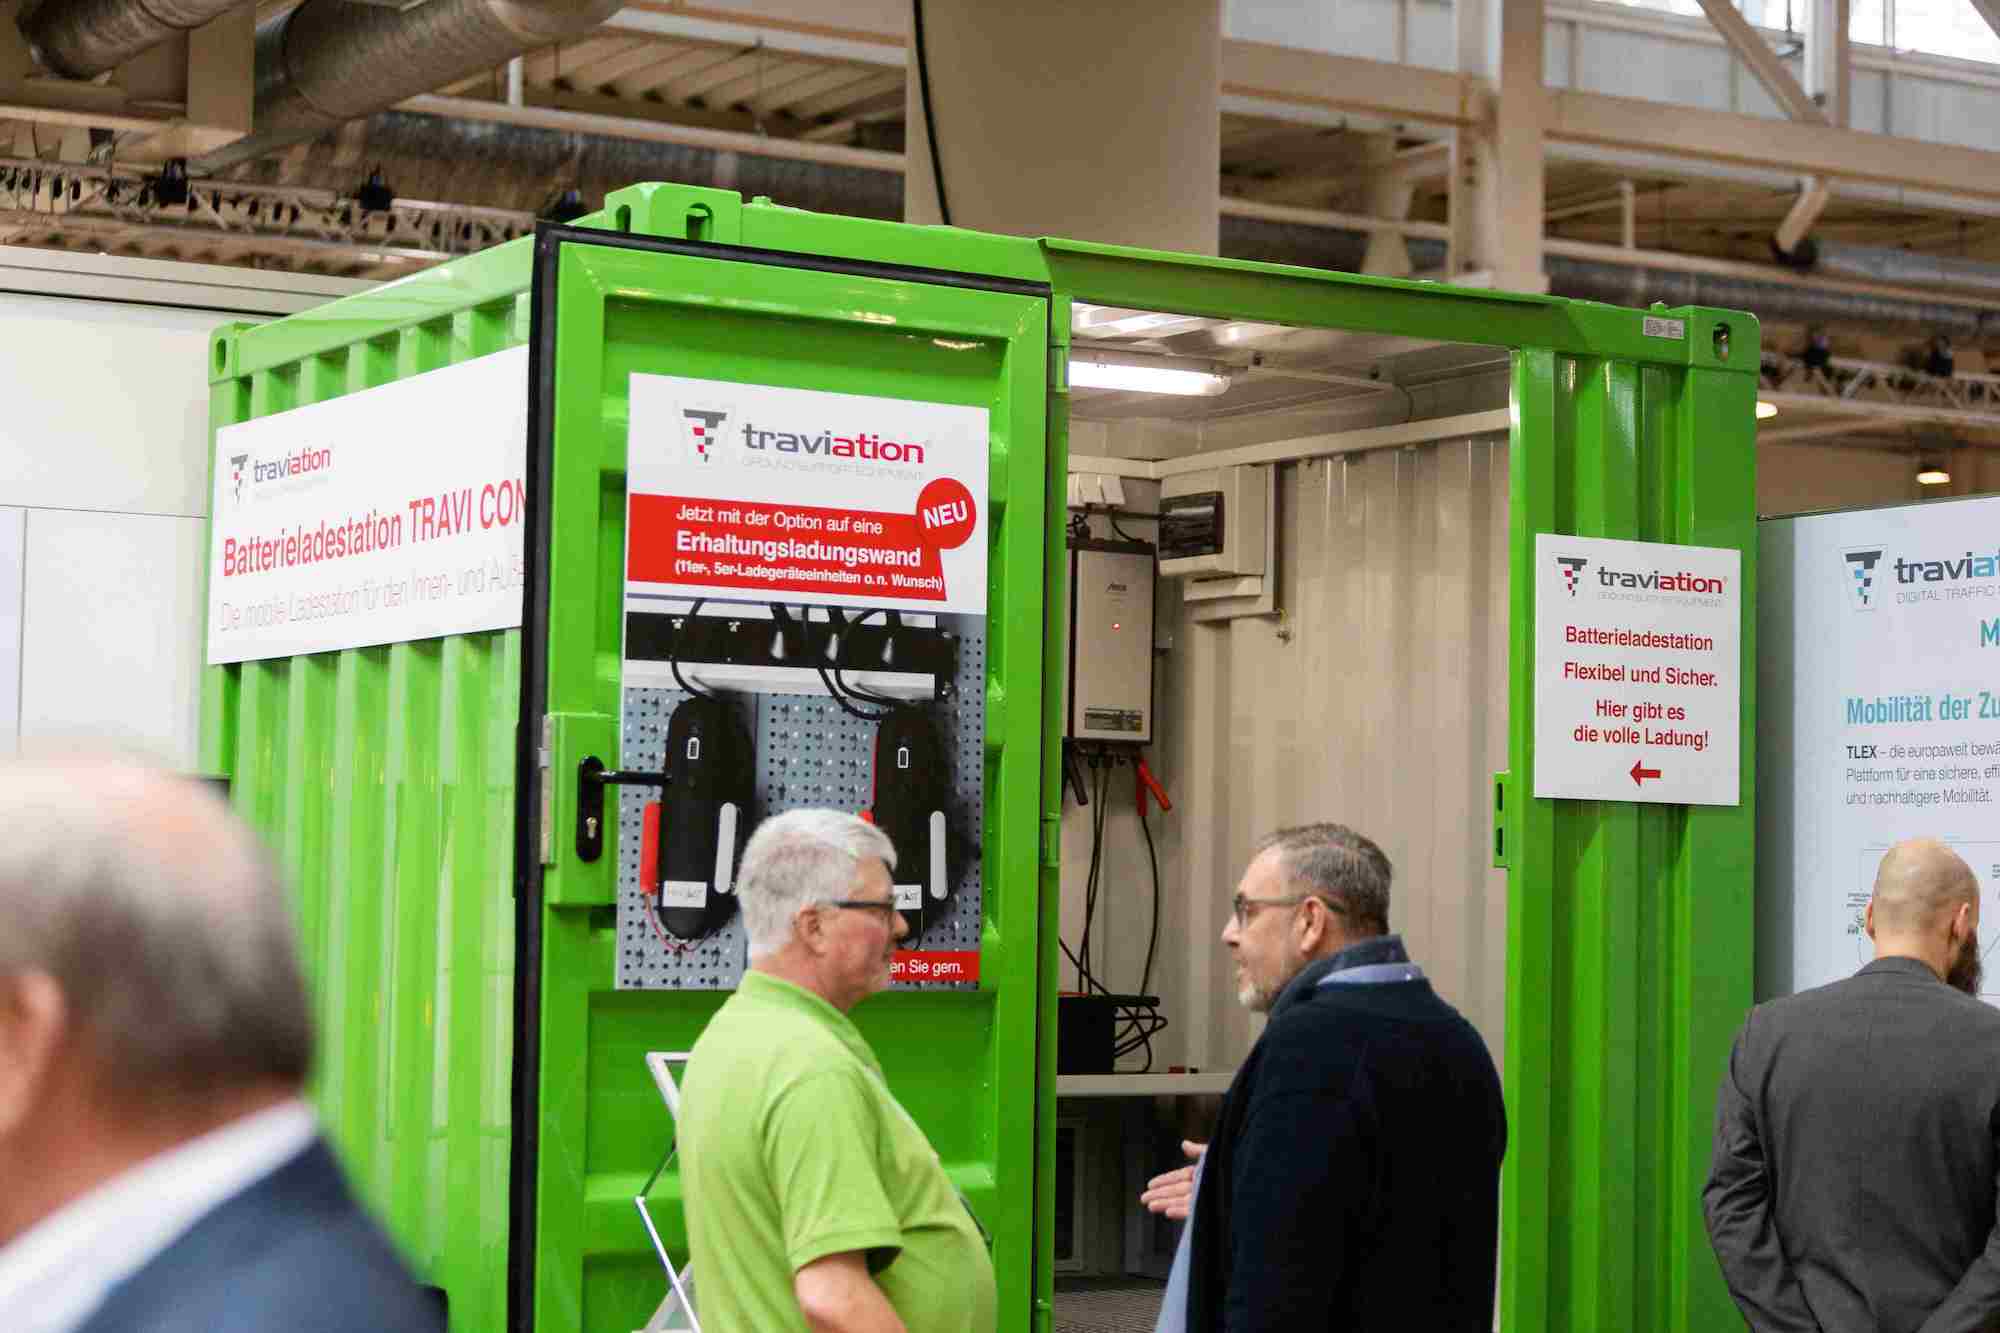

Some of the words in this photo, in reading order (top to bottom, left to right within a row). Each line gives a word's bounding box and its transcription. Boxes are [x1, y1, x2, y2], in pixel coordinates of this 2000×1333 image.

[742, 424, 925, 464] traviation
[254, 446, 331, 483] traviation
[676, 505, 714, 523] Jetzt
[717, 509, 742, 524] mit
[745, 510, 770, 526] der
[774, 512, 822, 532] Option
[826, 517, 849, 533] auf
[853, 519, 883, 535] eine
[923, 500, 968, 530] NEU
[224, 509, 402, 577] Batterieladestation
[409, 488, 473, 544] TRAVI
[676, 530, 921, 567] Erhaltungsladungswand
[891, 574, 943, 591] Wunsch)
[1597, 566, 1724, 595] traviation
[1566, 626, 1713, 651] Batterieladestation
[1564, 662, 1625, 682] Flexibel
[1631, 667, 1661, 684] und
[1665, 667, 1718, 687] Sicher.
[1596, 700, 1628, 718] Hier
[1633, 702, 1664, 722] gibt
[1667, 707, 1686, 721] es
[1847, 696, 1933, 725] Mobilität
[1939, 694, 1971, 721] der
[1574, 725, 1599, 742] die
[1603, 726, 1640, 744] volle
[1645, 728, 1709, 751] Ladung!
[1846, 745, 1878, 760] TLEX
[1889, 744, 1905, 759] die
[1908, 742, 1968, 761] europaweit
[1846, 767, 1894, 783] Plattform
[1896, 766, 1911, 782] für
[1913, 767, 1936, 781] eine
[1846, 791, 1867, 805] und
[909, 959, 929, 974] Sie
